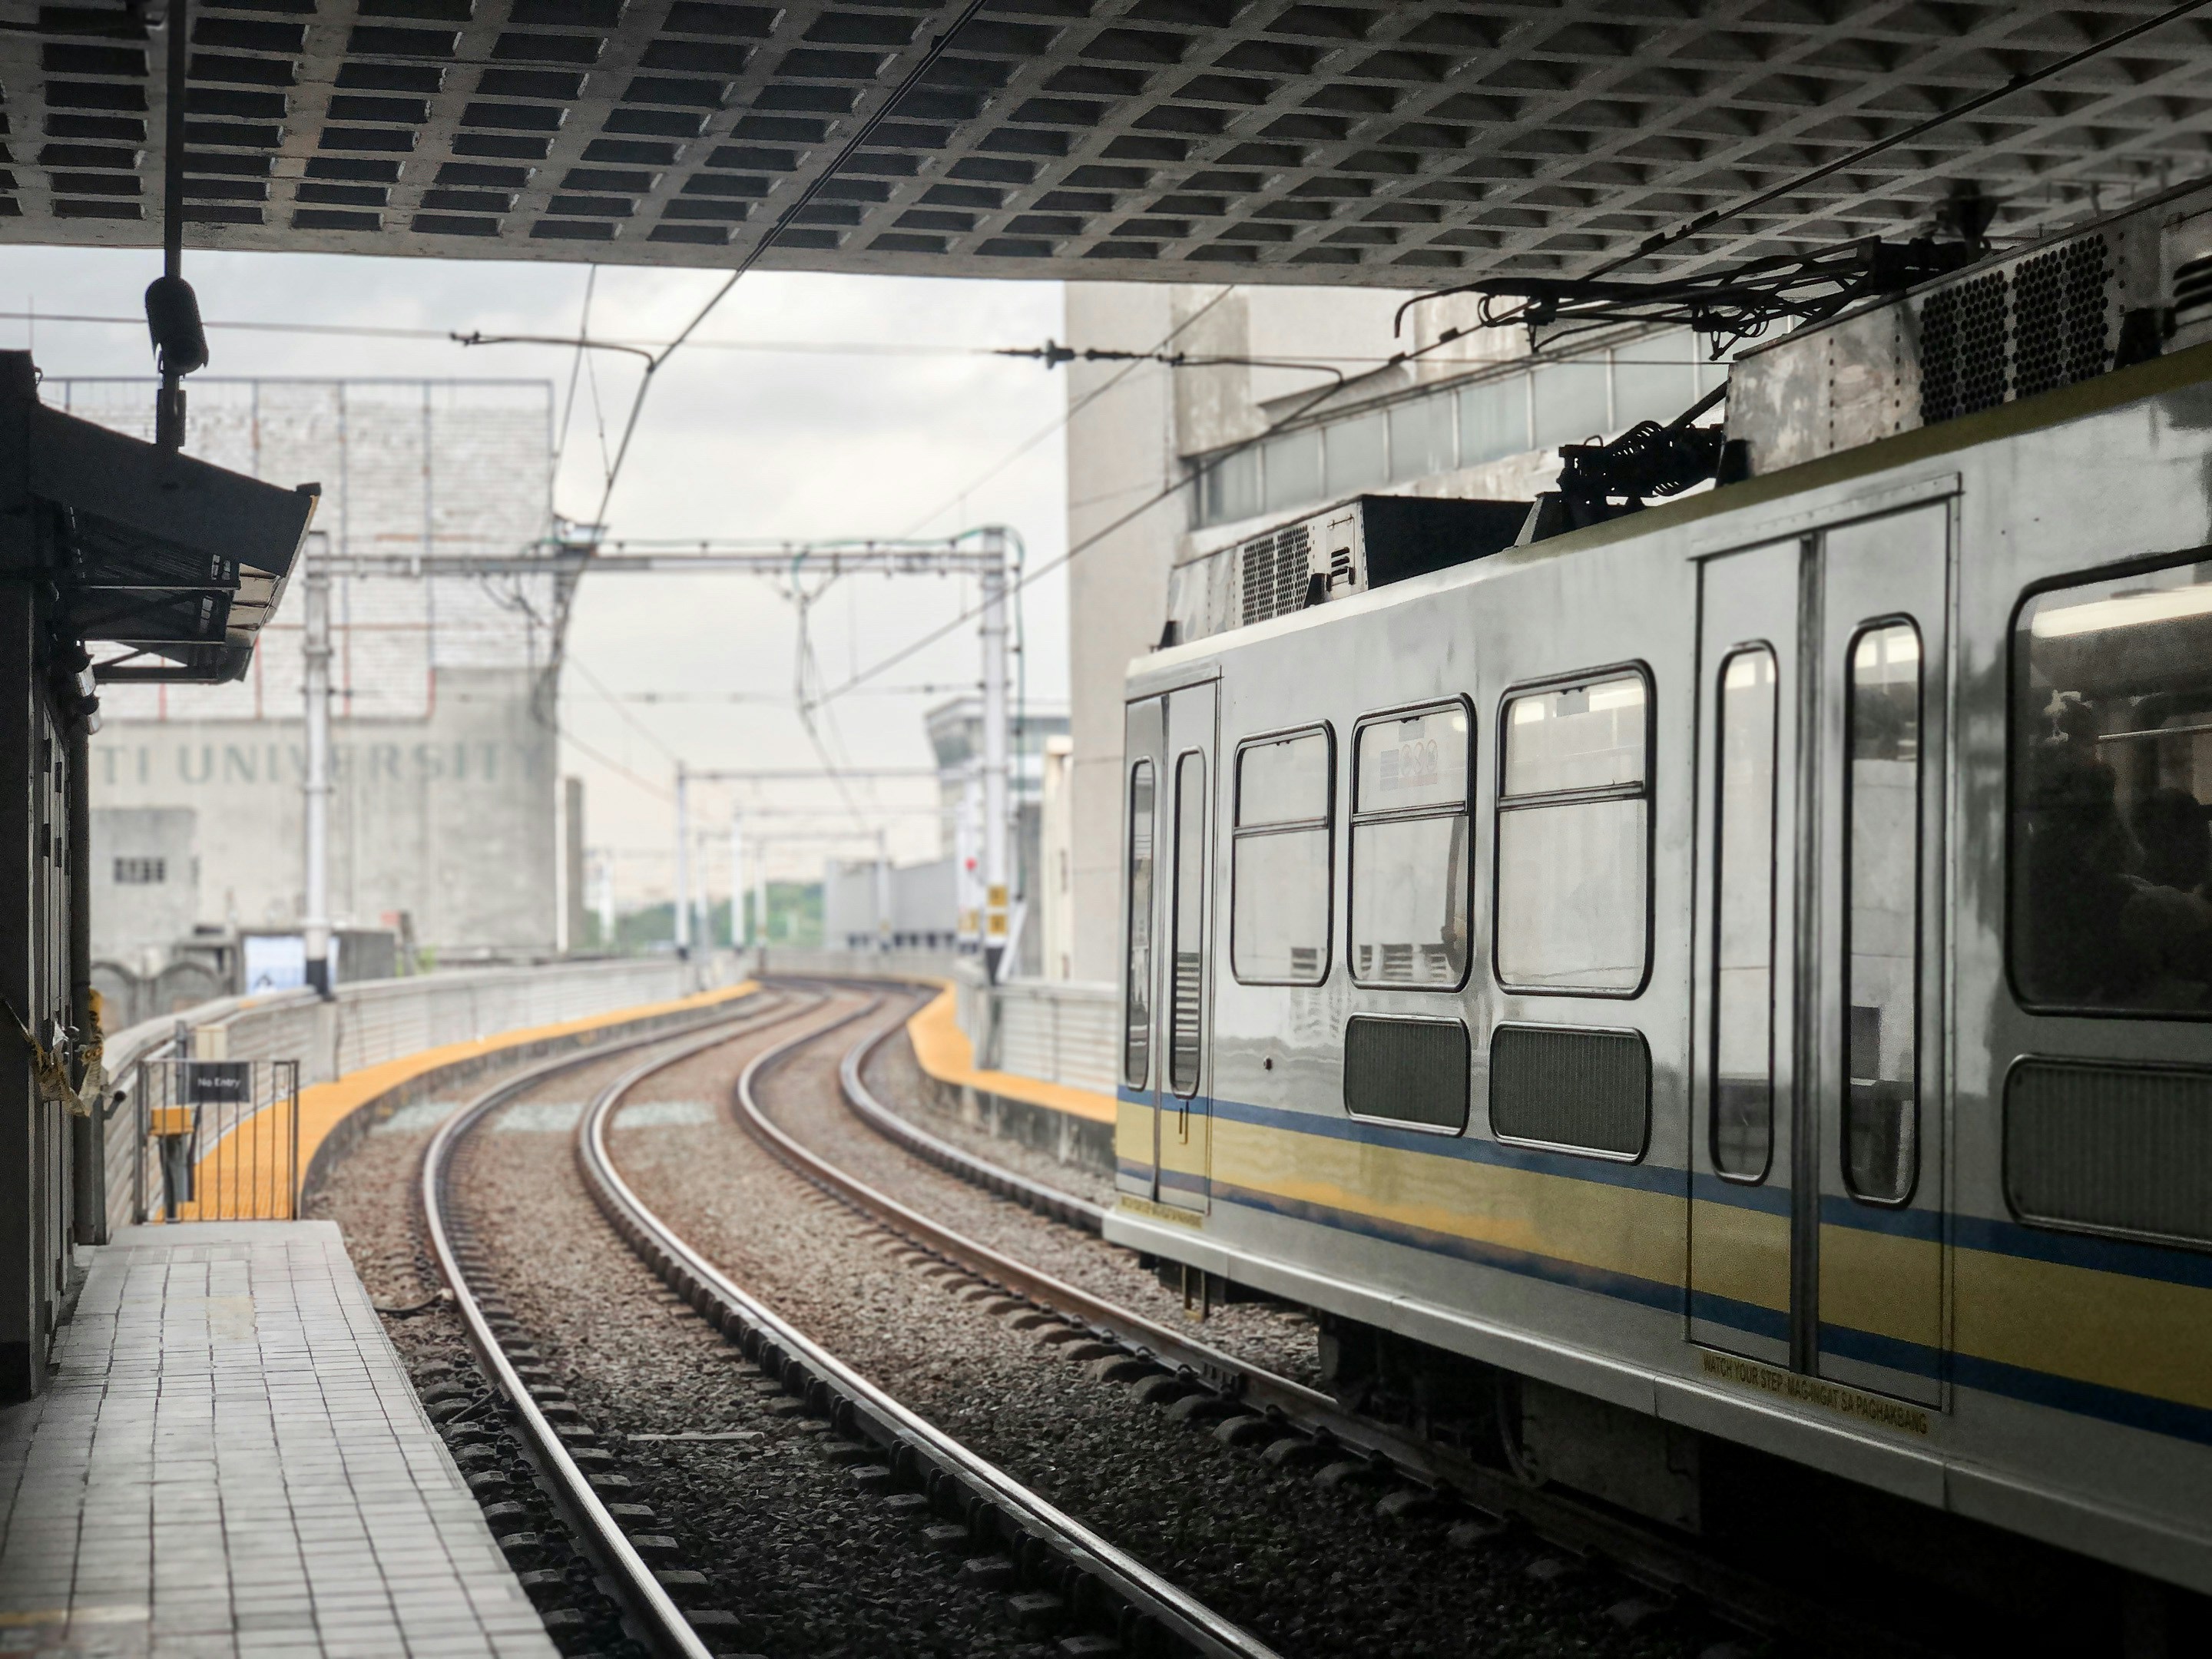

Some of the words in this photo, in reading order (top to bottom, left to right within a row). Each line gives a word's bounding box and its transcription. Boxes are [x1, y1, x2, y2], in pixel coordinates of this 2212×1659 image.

[197, 1077, 213, 1088] No
[214, 1077, 241, 1090] Entry
[1703, 1354, 1733, 1380] WATCH
[1734, 1359, 1759, 1386] YOUR
[1840, 1391, 1854, 1412] SA
